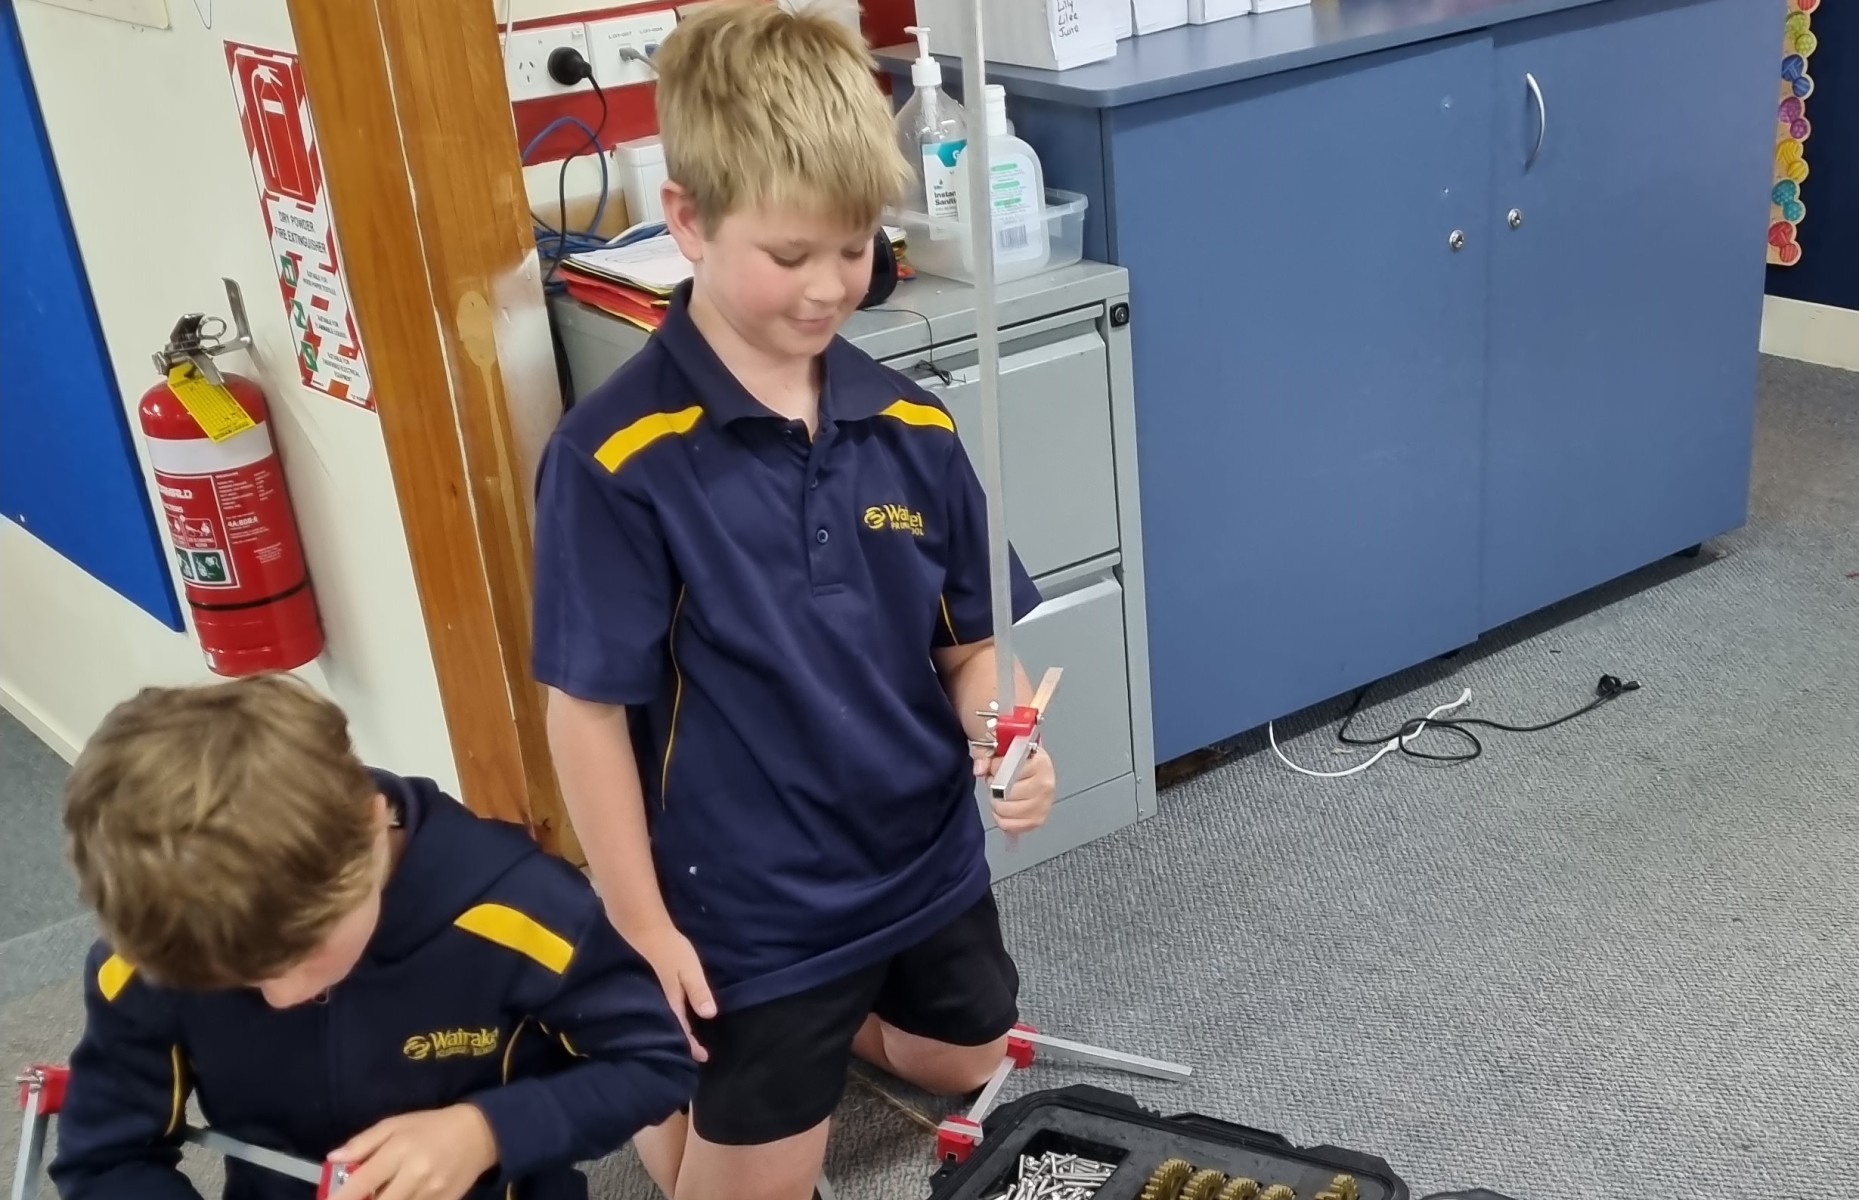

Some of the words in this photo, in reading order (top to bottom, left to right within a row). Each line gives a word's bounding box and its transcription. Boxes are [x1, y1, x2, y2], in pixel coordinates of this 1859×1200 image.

[934, 190, 958, 198] Instan
[278, 211, 290, 223] DRY
[290, 215, 315, 233] POWDER
[274, 226, 288, 241] FIRE
[287, 231, 327, 254] EXTINGUISHER
